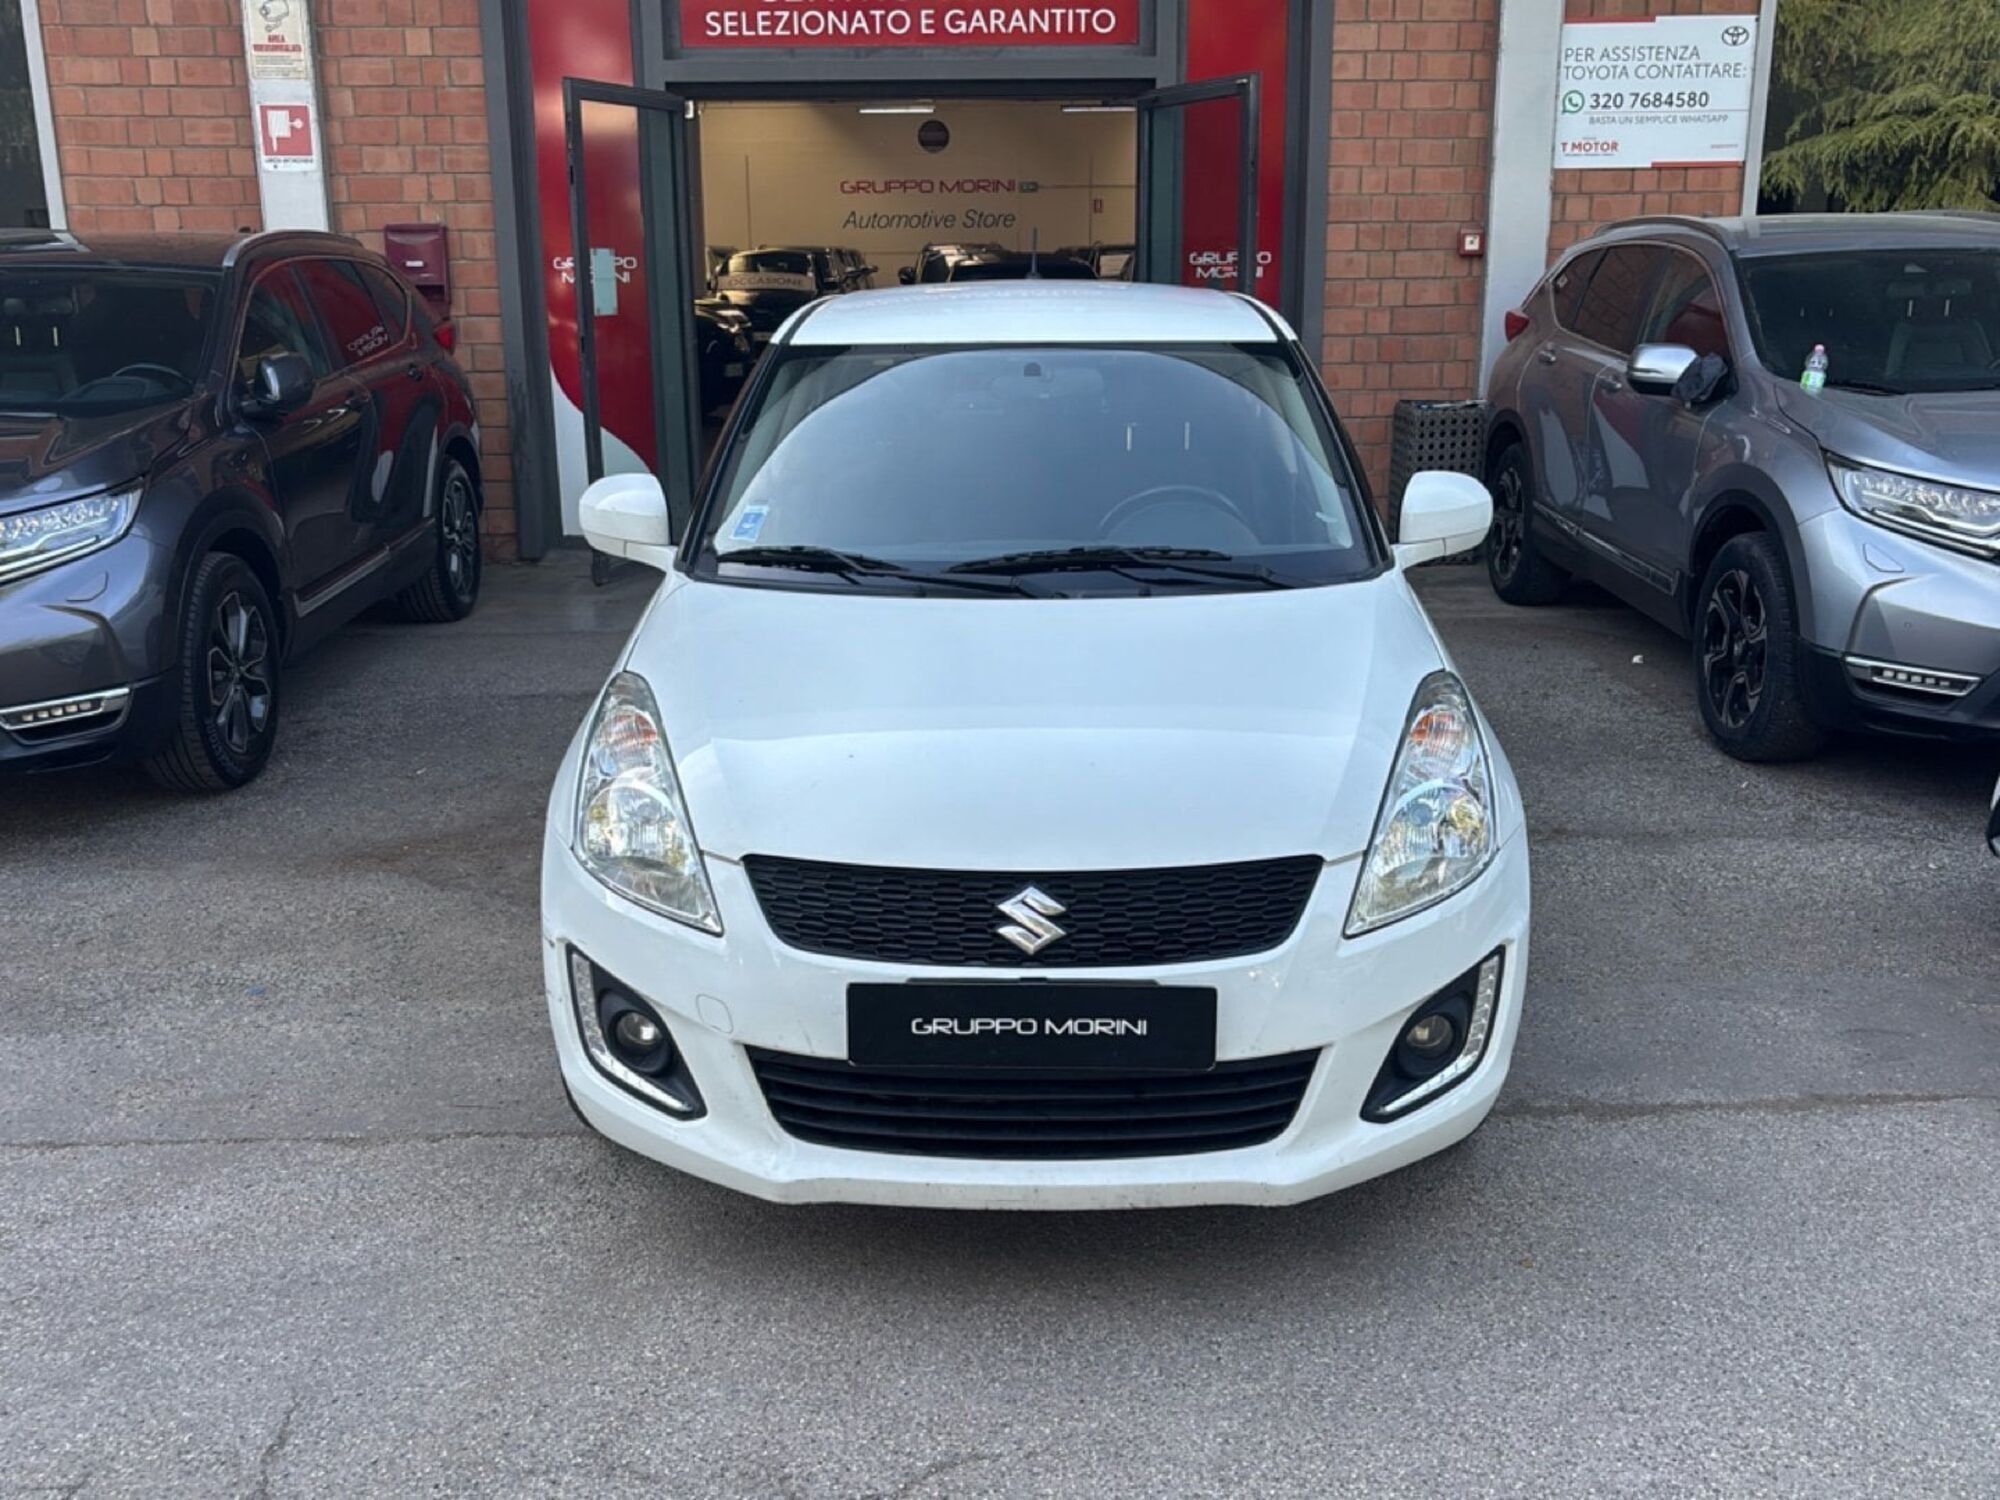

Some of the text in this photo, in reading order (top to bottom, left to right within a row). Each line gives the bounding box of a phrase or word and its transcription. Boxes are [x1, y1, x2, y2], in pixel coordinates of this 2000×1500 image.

[705, 9, 1116, 36] SELEZIONATO E GARANTITO
[1564, 46, 1700, 62] PER ASSISTENZA
[1564, 63, 1747, 80] TOYOTA CONTATTARE:
[1590, 92, 1709, 109] 320 7684580
[1589, 114, 1728, 125] BASTA UN SEMPLICE WHATSAPP
[1571, 141, 1619, 152] MOTOR
[840, 179, 934, 194] GRUPPO
[939, 179, 1016, 193] MORINI
[843, 208, 1016, 229] Automotive Store
[911, 1018, 1147, 1036] GRUPPO MORINI
